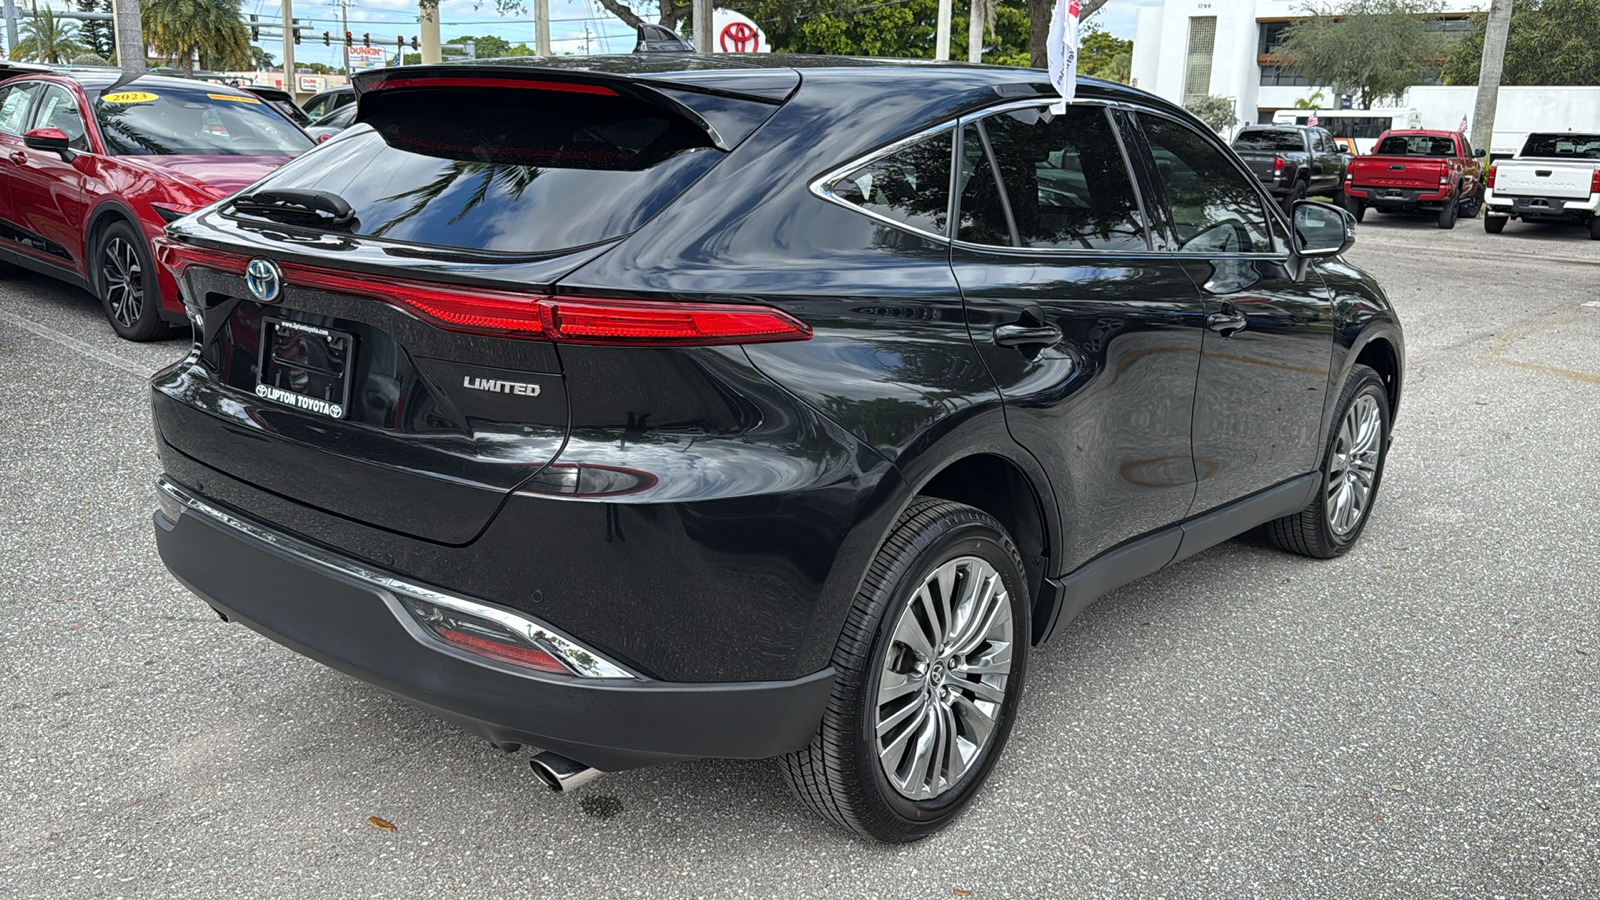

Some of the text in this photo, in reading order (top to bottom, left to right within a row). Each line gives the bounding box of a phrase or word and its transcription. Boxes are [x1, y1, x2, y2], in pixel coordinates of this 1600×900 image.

[112, 93, 147, 102] 2023
[1510, 180, 1576, 189] TACOMA
[281, 321, 329, 336] www.liptontoyota.com
[463, 375, 541, 397] LIMITED
[266, 387, 330, 415] LIPTON TOYOTA
